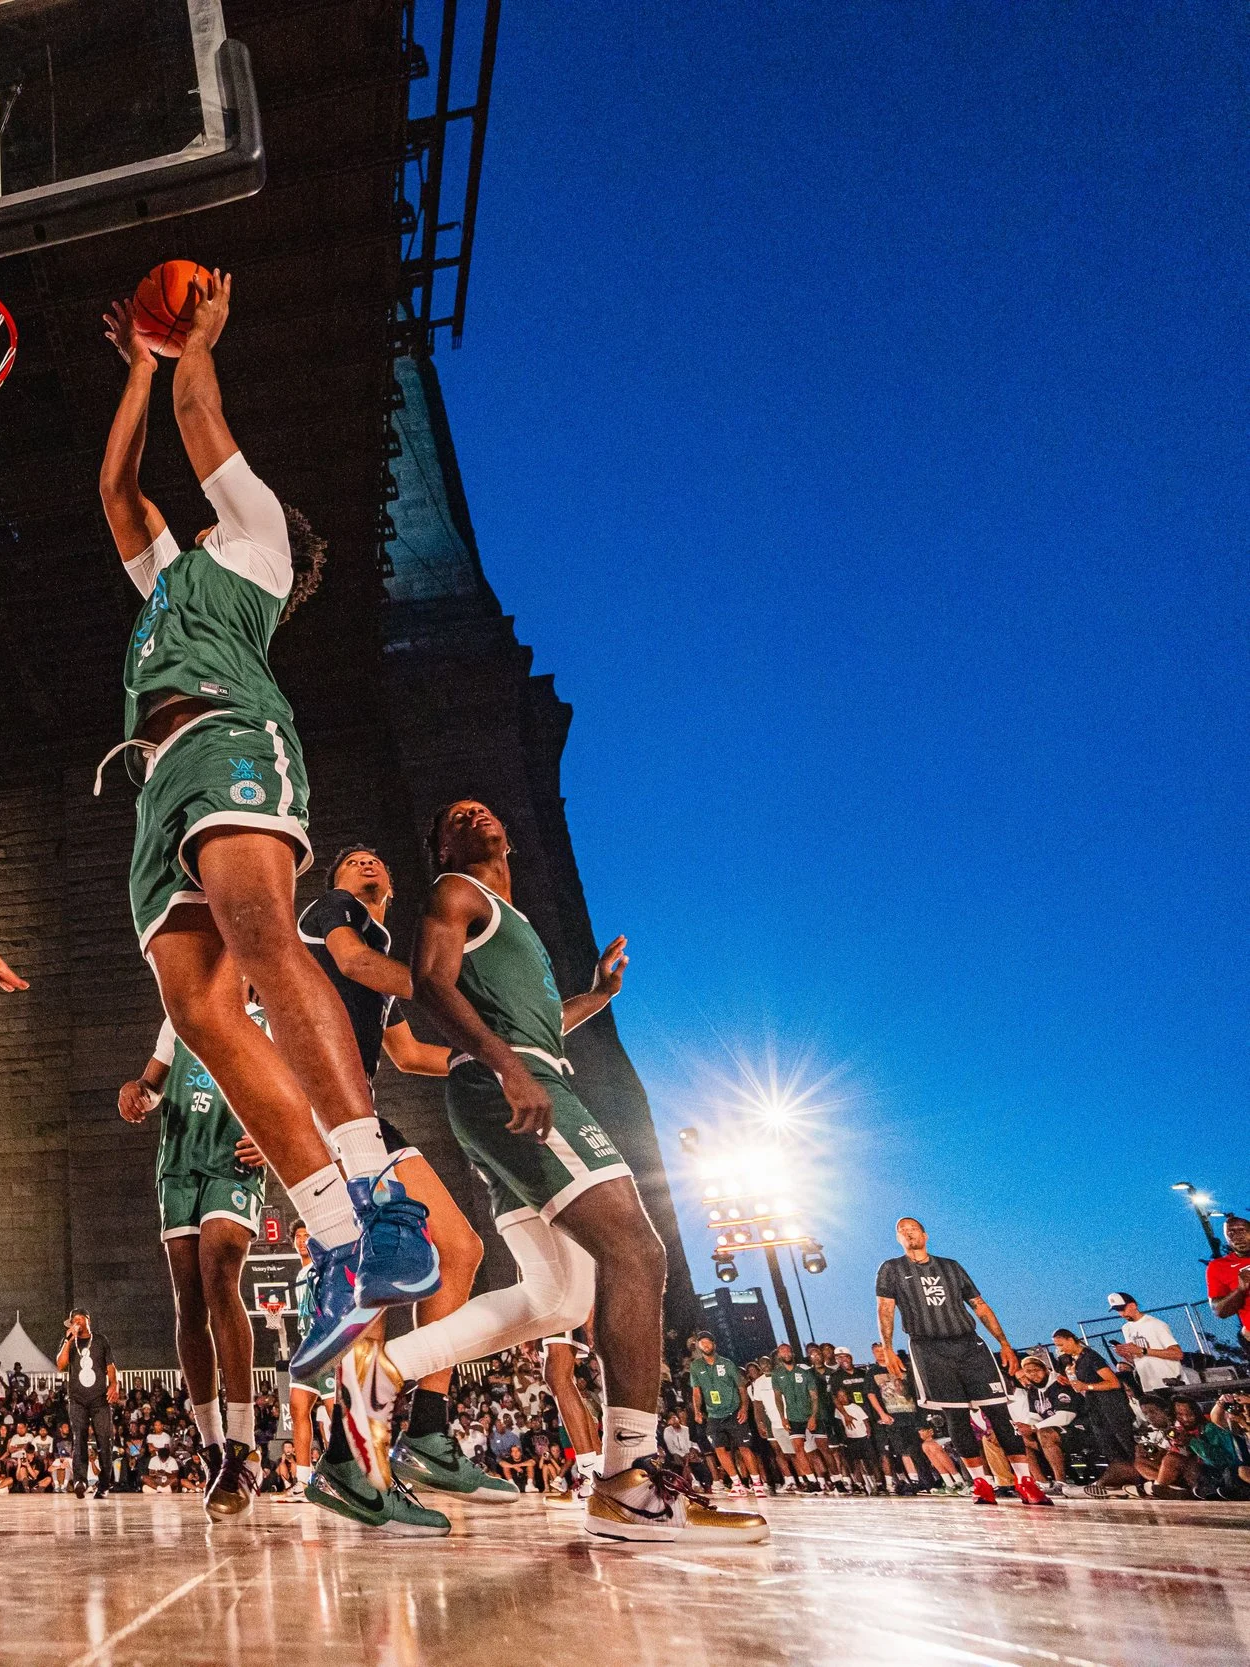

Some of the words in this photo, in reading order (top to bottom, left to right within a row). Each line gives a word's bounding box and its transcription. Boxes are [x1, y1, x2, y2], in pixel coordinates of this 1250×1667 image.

[191, 1092, 213, 1113] 35
[266, 1220, 279, 1241] 3
[920, 1276, 941, 1286] NY
[923, 1286, 946, 1296] VS
[926, 1297, 947, 1306] NY
